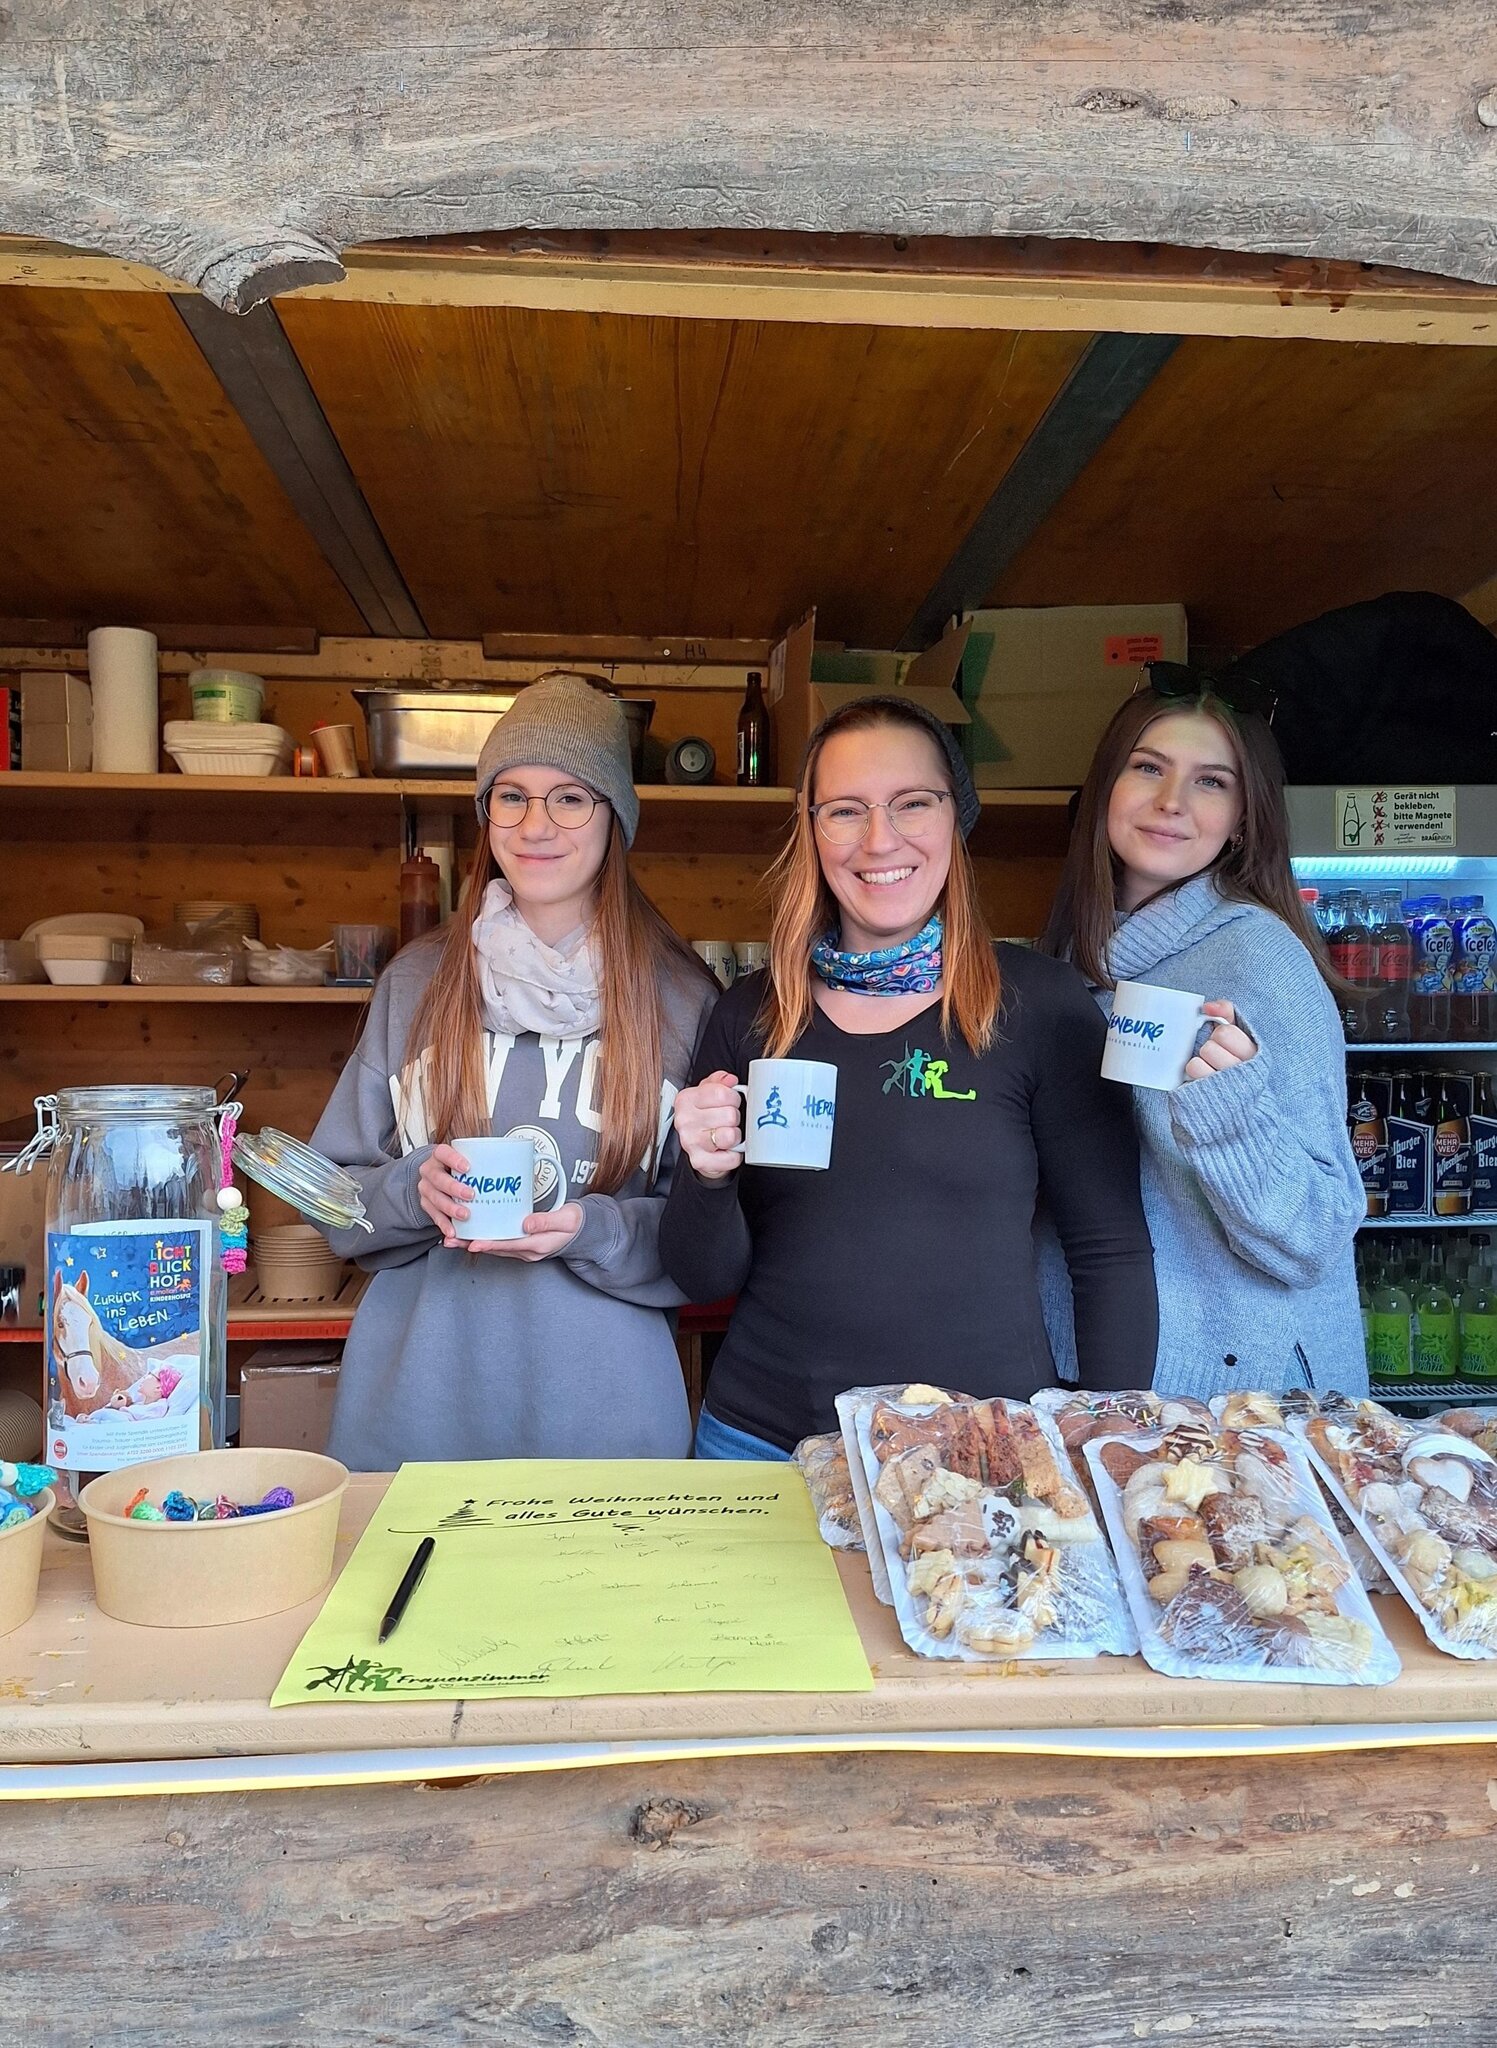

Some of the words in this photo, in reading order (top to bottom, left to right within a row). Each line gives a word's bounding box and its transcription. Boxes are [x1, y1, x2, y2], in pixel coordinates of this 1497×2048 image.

[1394, 792, 1417, 800] Gerät
[1419, 791, 1440, 800] nicht
[1394, 802, 1435, 810] bekleben,
[1393, 812, 1414, 820] bitte
[1415, 811, 1452, 821] Magnete
[1394, 821, 1443, 830] verwenden!
[803, 1094, 835, 1121] HERZ
[1392, 1136, 1420, 1156] lburger
[1436, 1138, 1458, 1146] MEHR
[1438, 1145, 1455, 1153] WEG
[1396, 1154, 1417, 1169] Bier
[571, 1159, 599, 1184] 197
[149, 1259, 192, 1274] BLICK
[150, 1274, 181, 1288] HOF
[106, 1307, 127, 1319] ins
[486, 1498, 554, 1507] Frohe
[568, 1494, 722, 1504] Weihnachten
[736, 1493, 780, 1501] und
[505, 1510, 558, 1520] alles
[572, 1509, 633, 1518] Gute
[648, 1507, 769, 1515] wünschen.
[397, 1672, 550, 1684] Frauenzimmer
